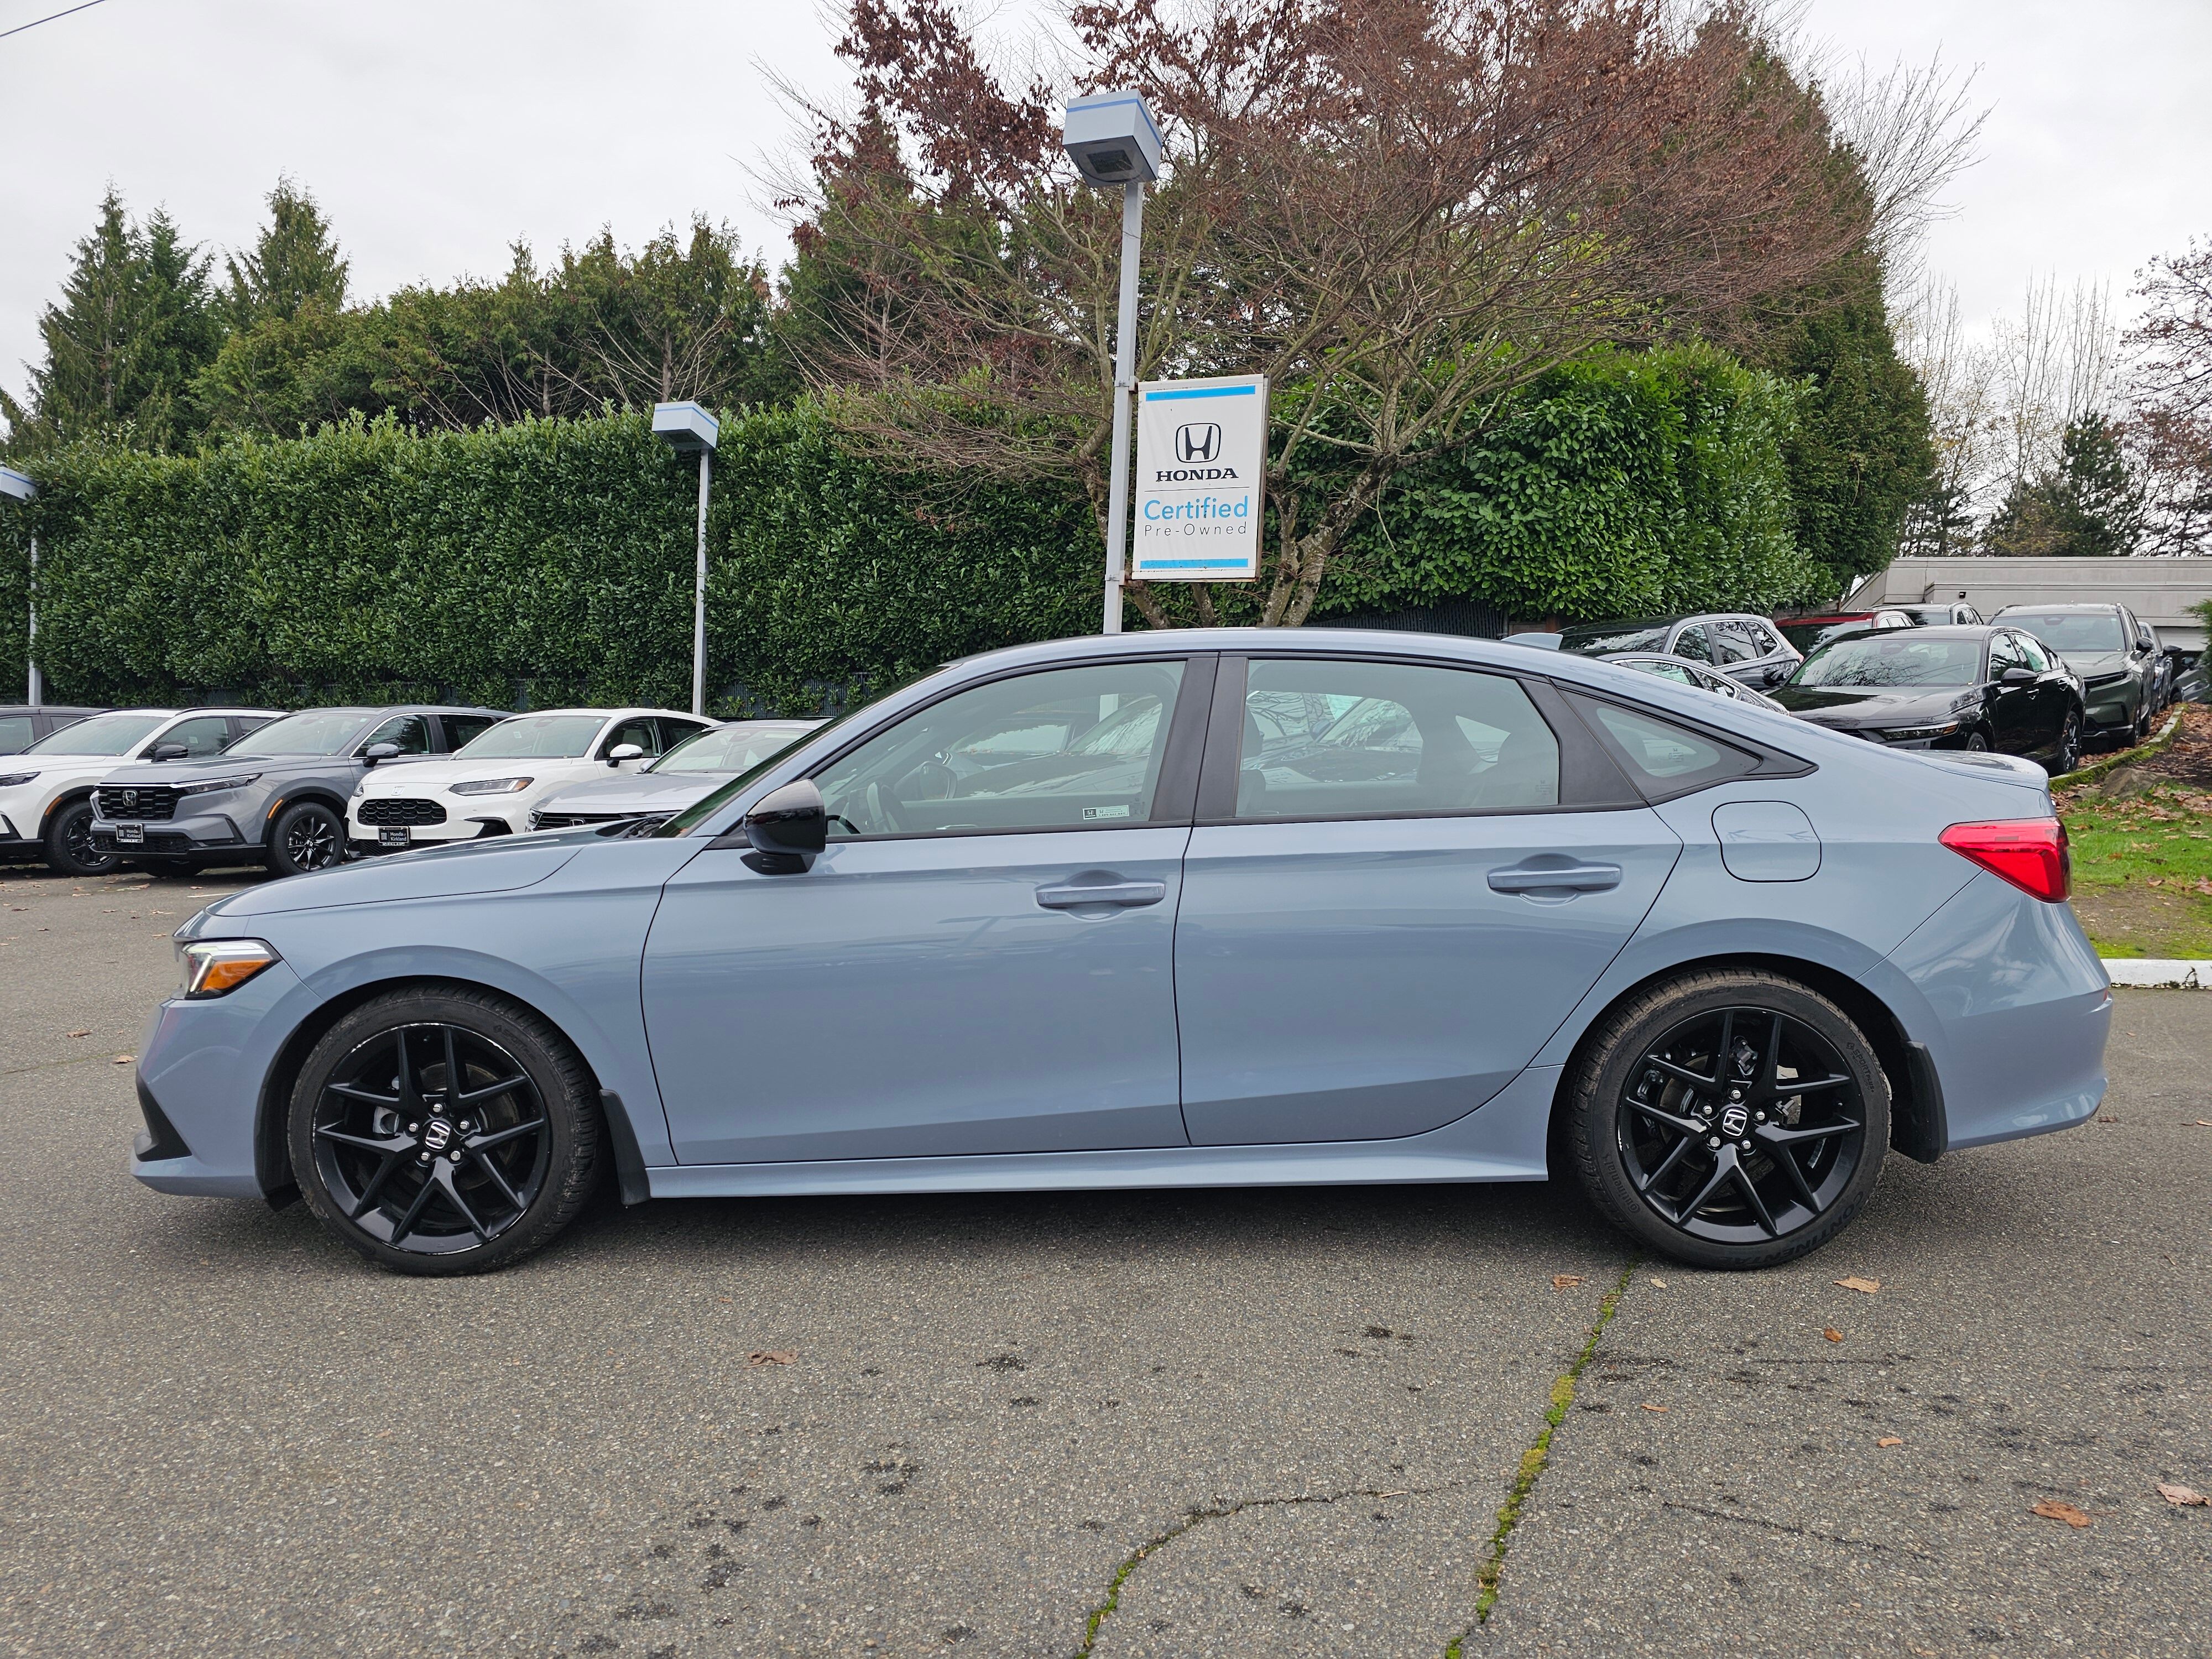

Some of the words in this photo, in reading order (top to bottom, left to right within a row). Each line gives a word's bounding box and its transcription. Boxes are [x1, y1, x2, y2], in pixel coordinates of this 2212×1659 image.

[1156, 468, 1239, 482] HONDA
[1144, 495, 1248, 520] Certified
[1145, 521, 1246, 536] Pre-Owned
[1604, 1161, 1641, 1213] Continental
